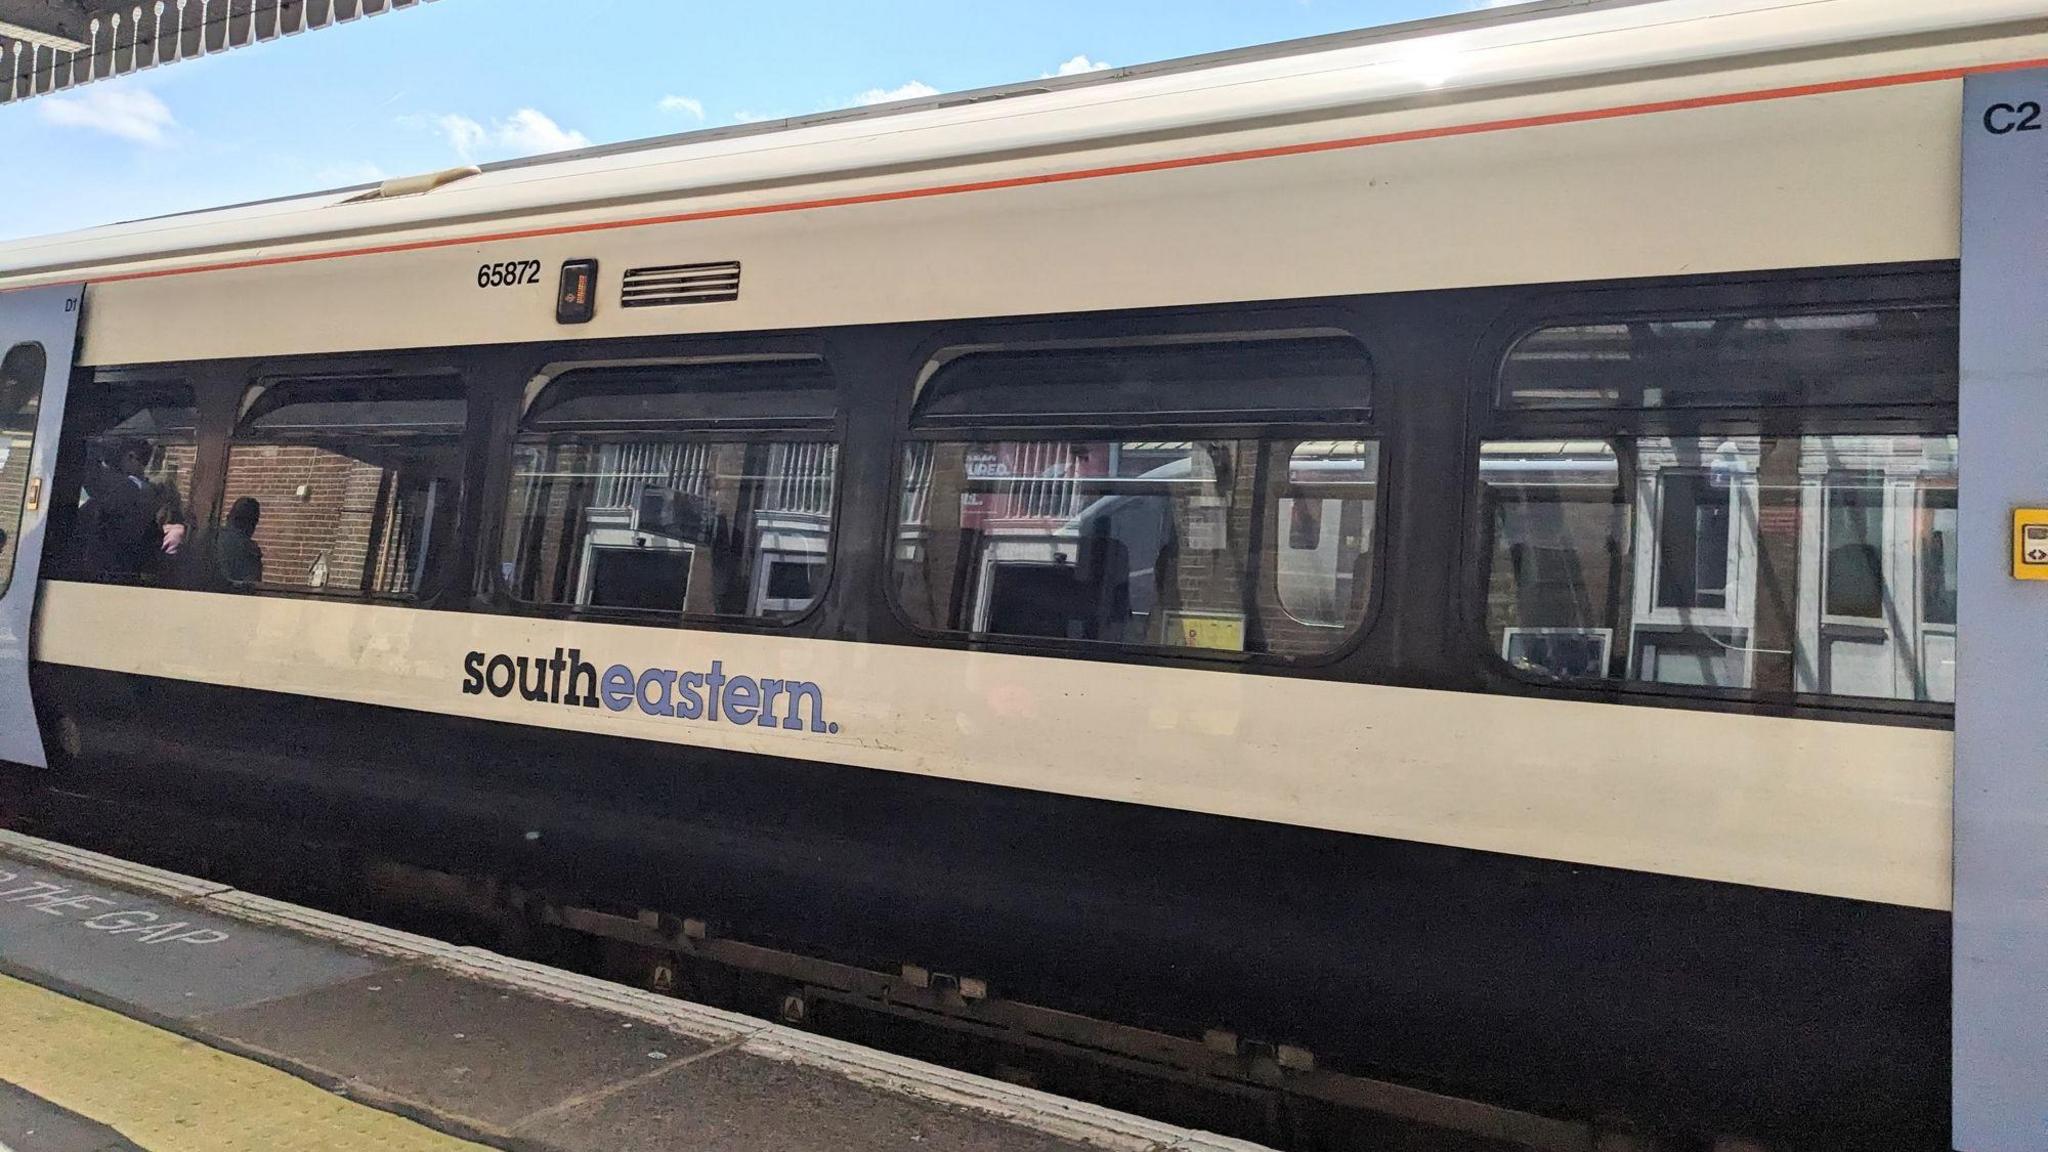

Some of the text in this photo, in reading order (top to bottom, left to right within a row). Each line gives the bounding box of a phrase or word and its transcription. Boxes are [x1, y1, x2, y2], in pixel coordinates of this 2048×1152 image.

[1983, 101, 2042, 135] C2
[477, 259, 541, 288] 65872
[65, 298, 77, 312] D1
[0, 881, 229, 944] THE GAP
